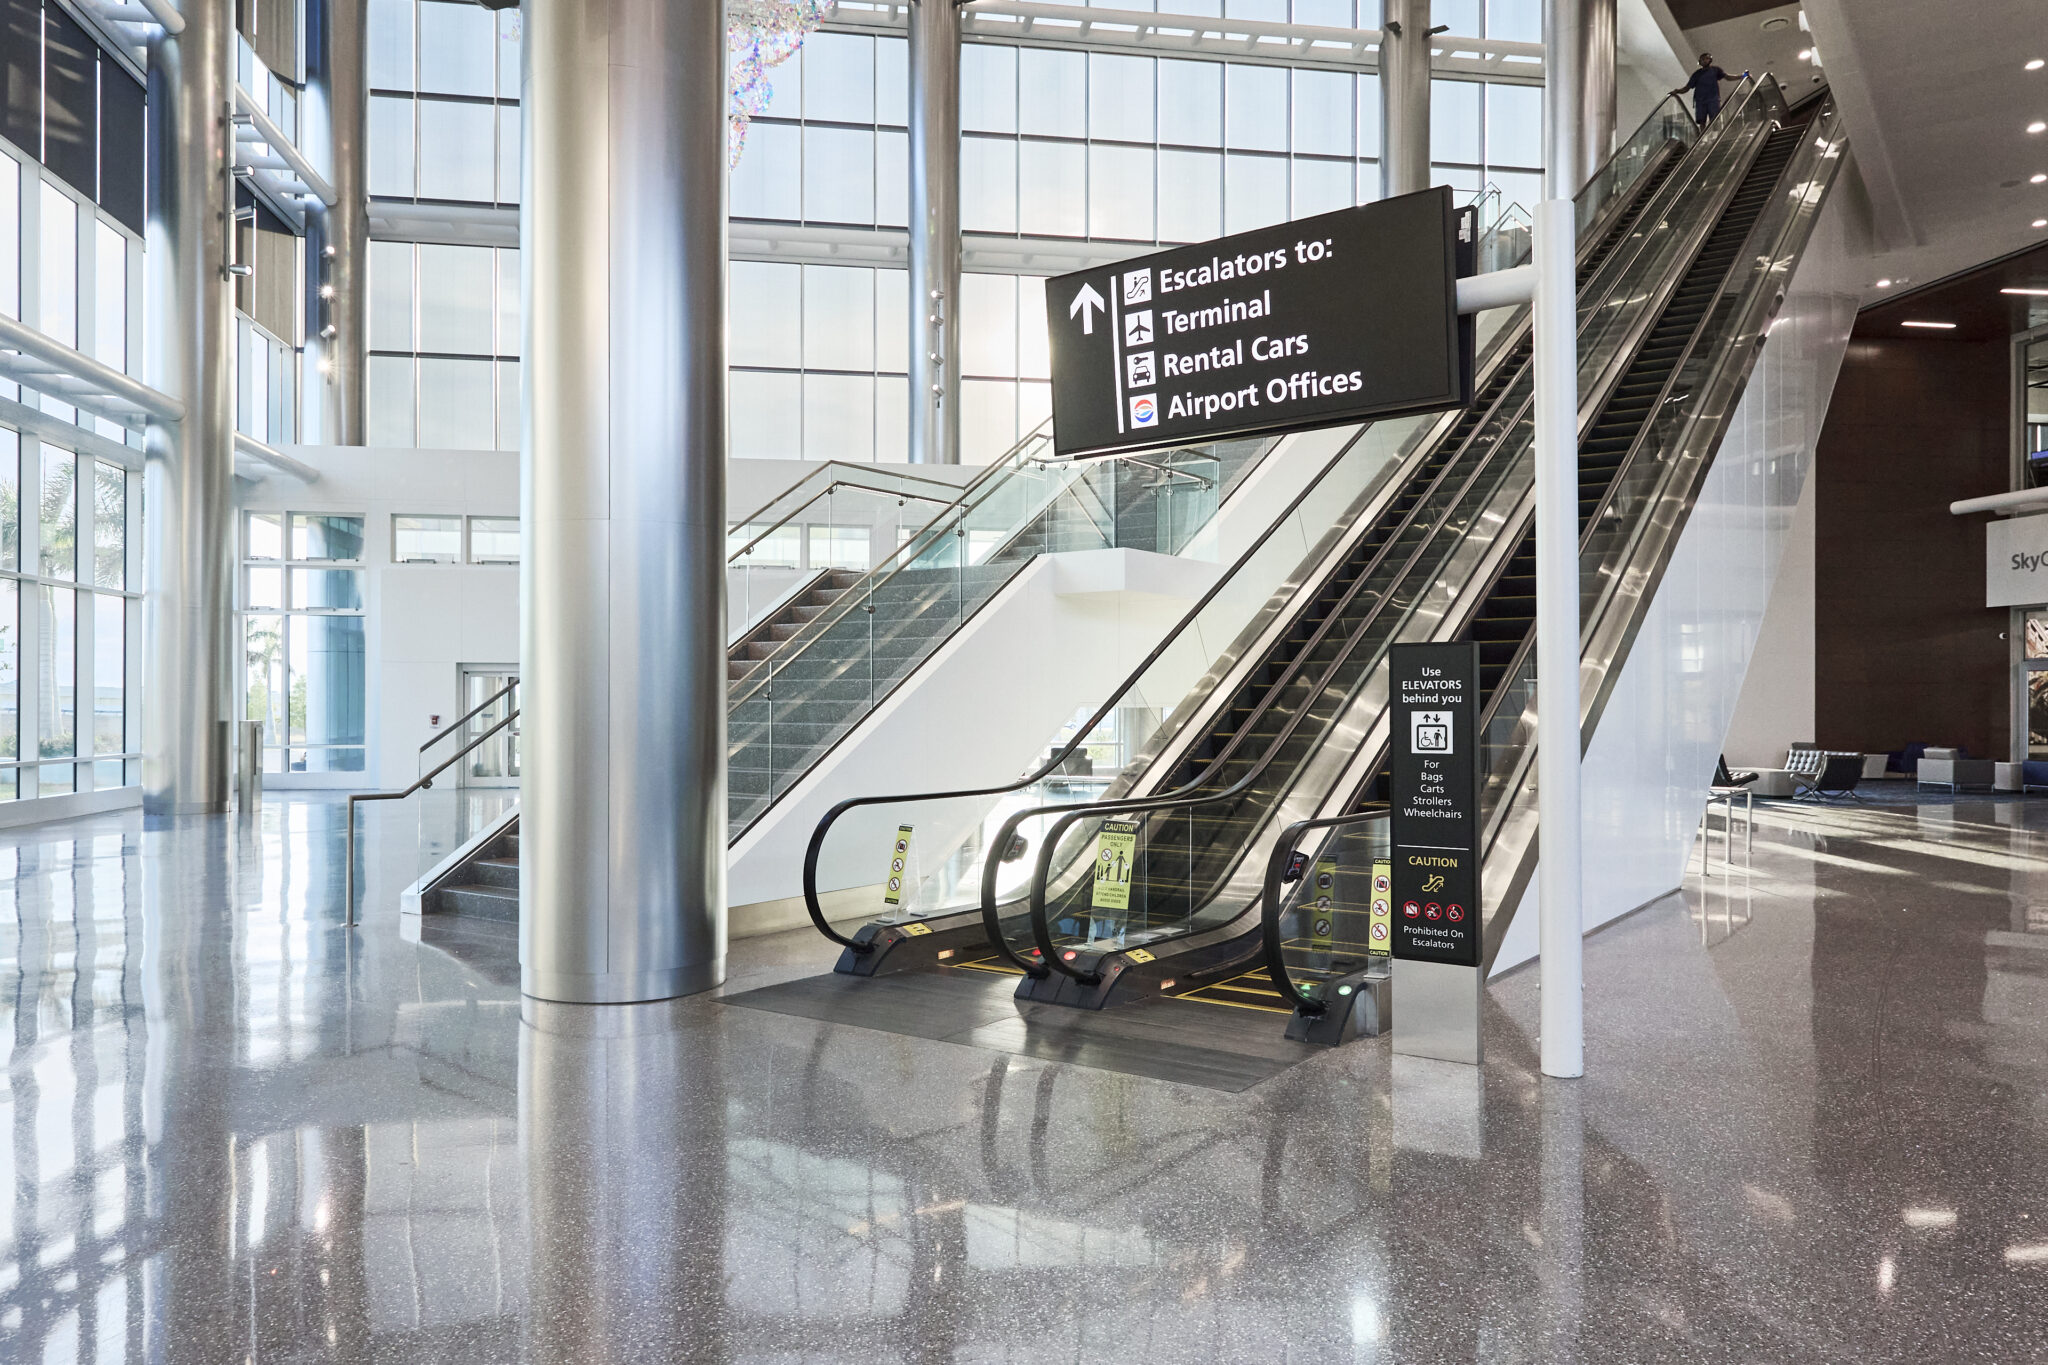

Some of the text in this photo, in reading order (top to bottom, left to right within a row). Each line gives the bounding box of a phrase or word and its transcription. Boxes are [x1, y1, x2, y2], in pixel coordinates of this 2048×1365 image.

[1160, 237, 1333, 293] Escalators to:
[1161, 290, 1271, 335] Terminal
[1164, 334, 1309, 378] Rental Cars
[1167, 370, 1363, 420] Airport Offices
[1421, 667, 1442, 677] Use
[1402, 680, 1462, 690] ELEVATORS
[1402, 693, 1462, 706] behind you
[1424, 760, 1440, 769] For
[1421, 772, 1444, 783] Bags
[1420, 784, 1445, 794] Carts
[1413, 796, 1452, 806] Strollers
[1404, 808, 1462, 819] Wheelchairs
[1105, 823, 1133, 832] CAUTION
[1101, 834, 1133, 842] PASSENGERS
[1408, 856, 1458, 868] CAUTION
[1403, 925, 1464, 939] Prohibited On
[1413, 938, 1455, 949] Escalators
